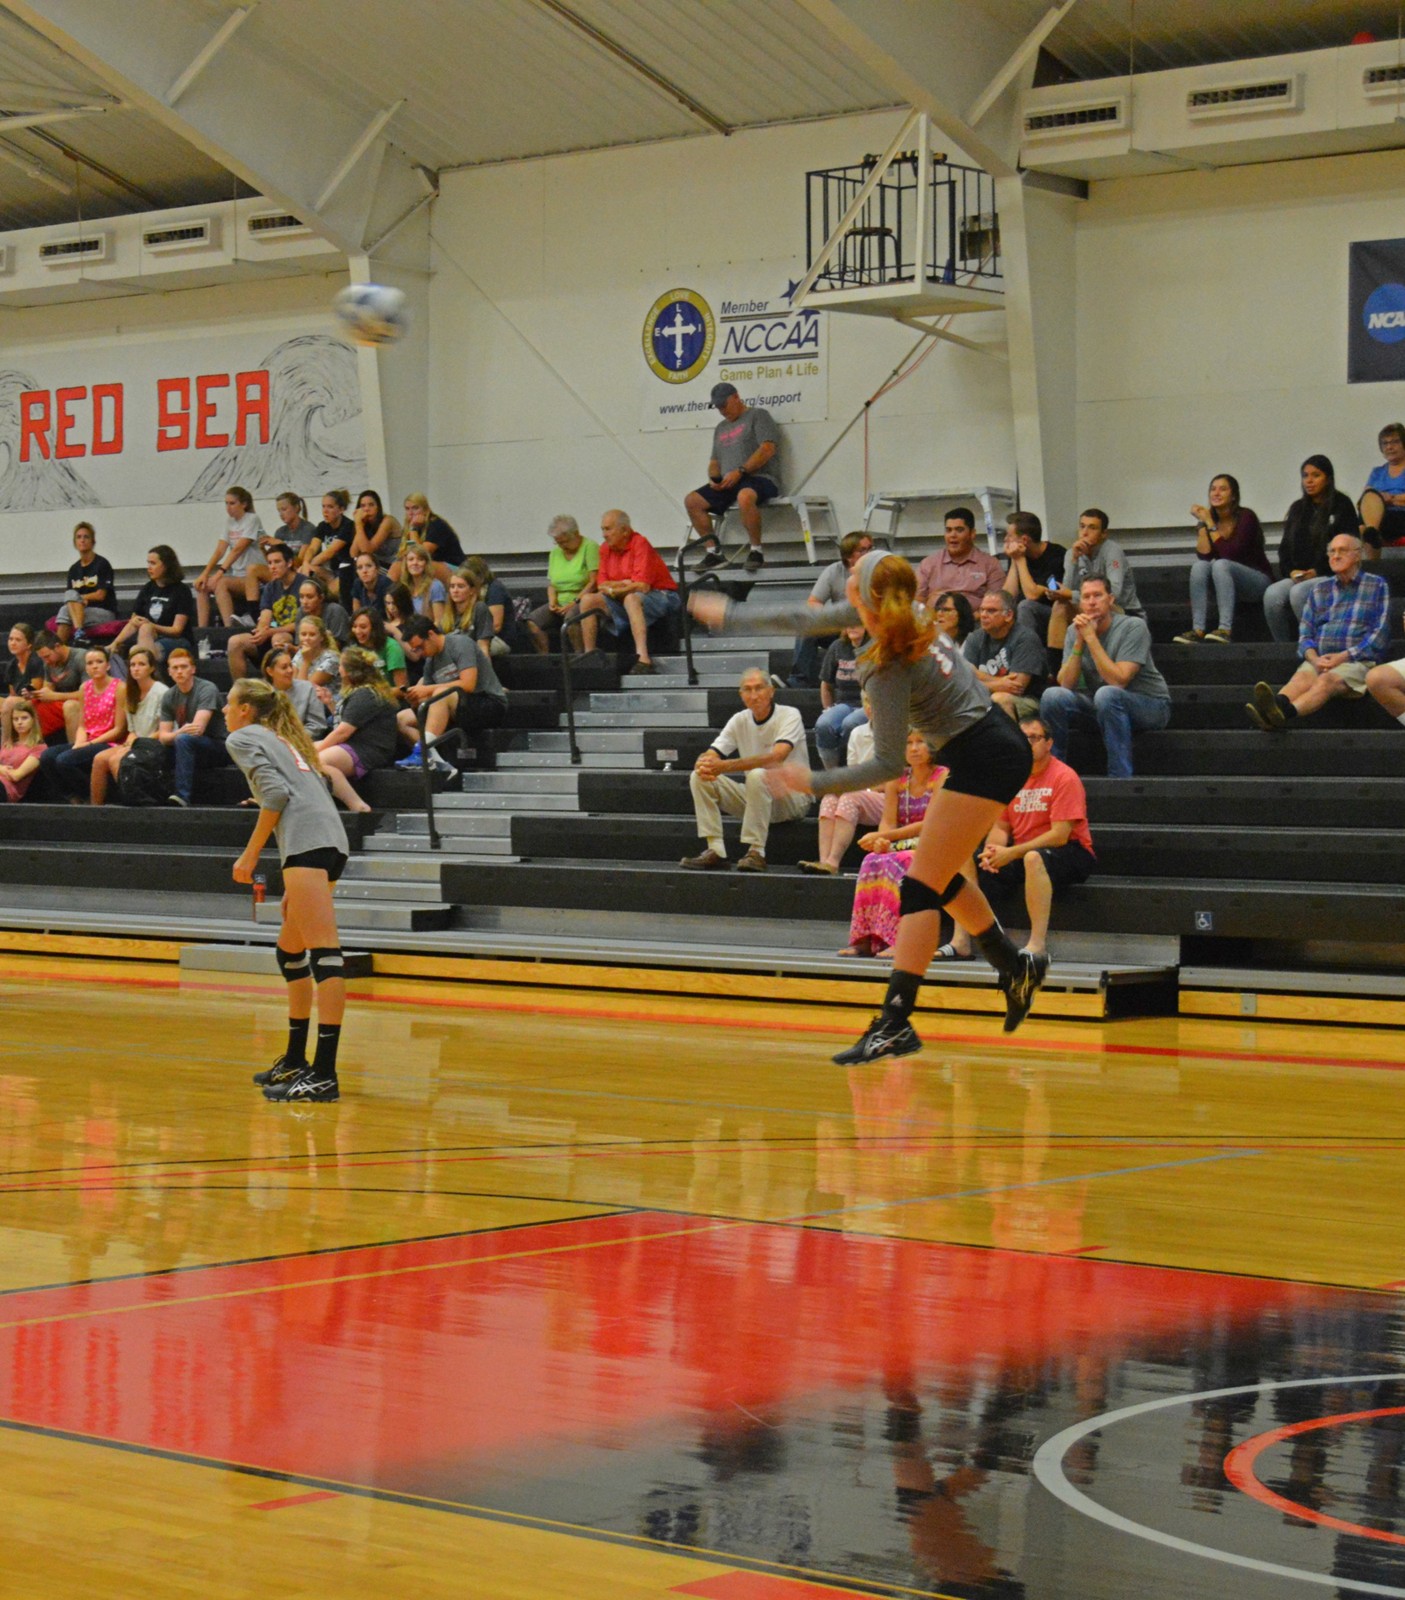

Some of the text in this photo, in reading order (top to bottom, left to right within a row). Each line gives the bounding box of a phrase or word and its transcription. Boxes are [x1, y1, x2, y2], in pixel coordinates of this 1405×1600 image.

[720, 300, 769, 315] Member
[723, 319, 818, 354] NCCAA
[720, 361, 819, 381] Game Plan 4 Life
[19, 369, 270, 463] RED SEA
